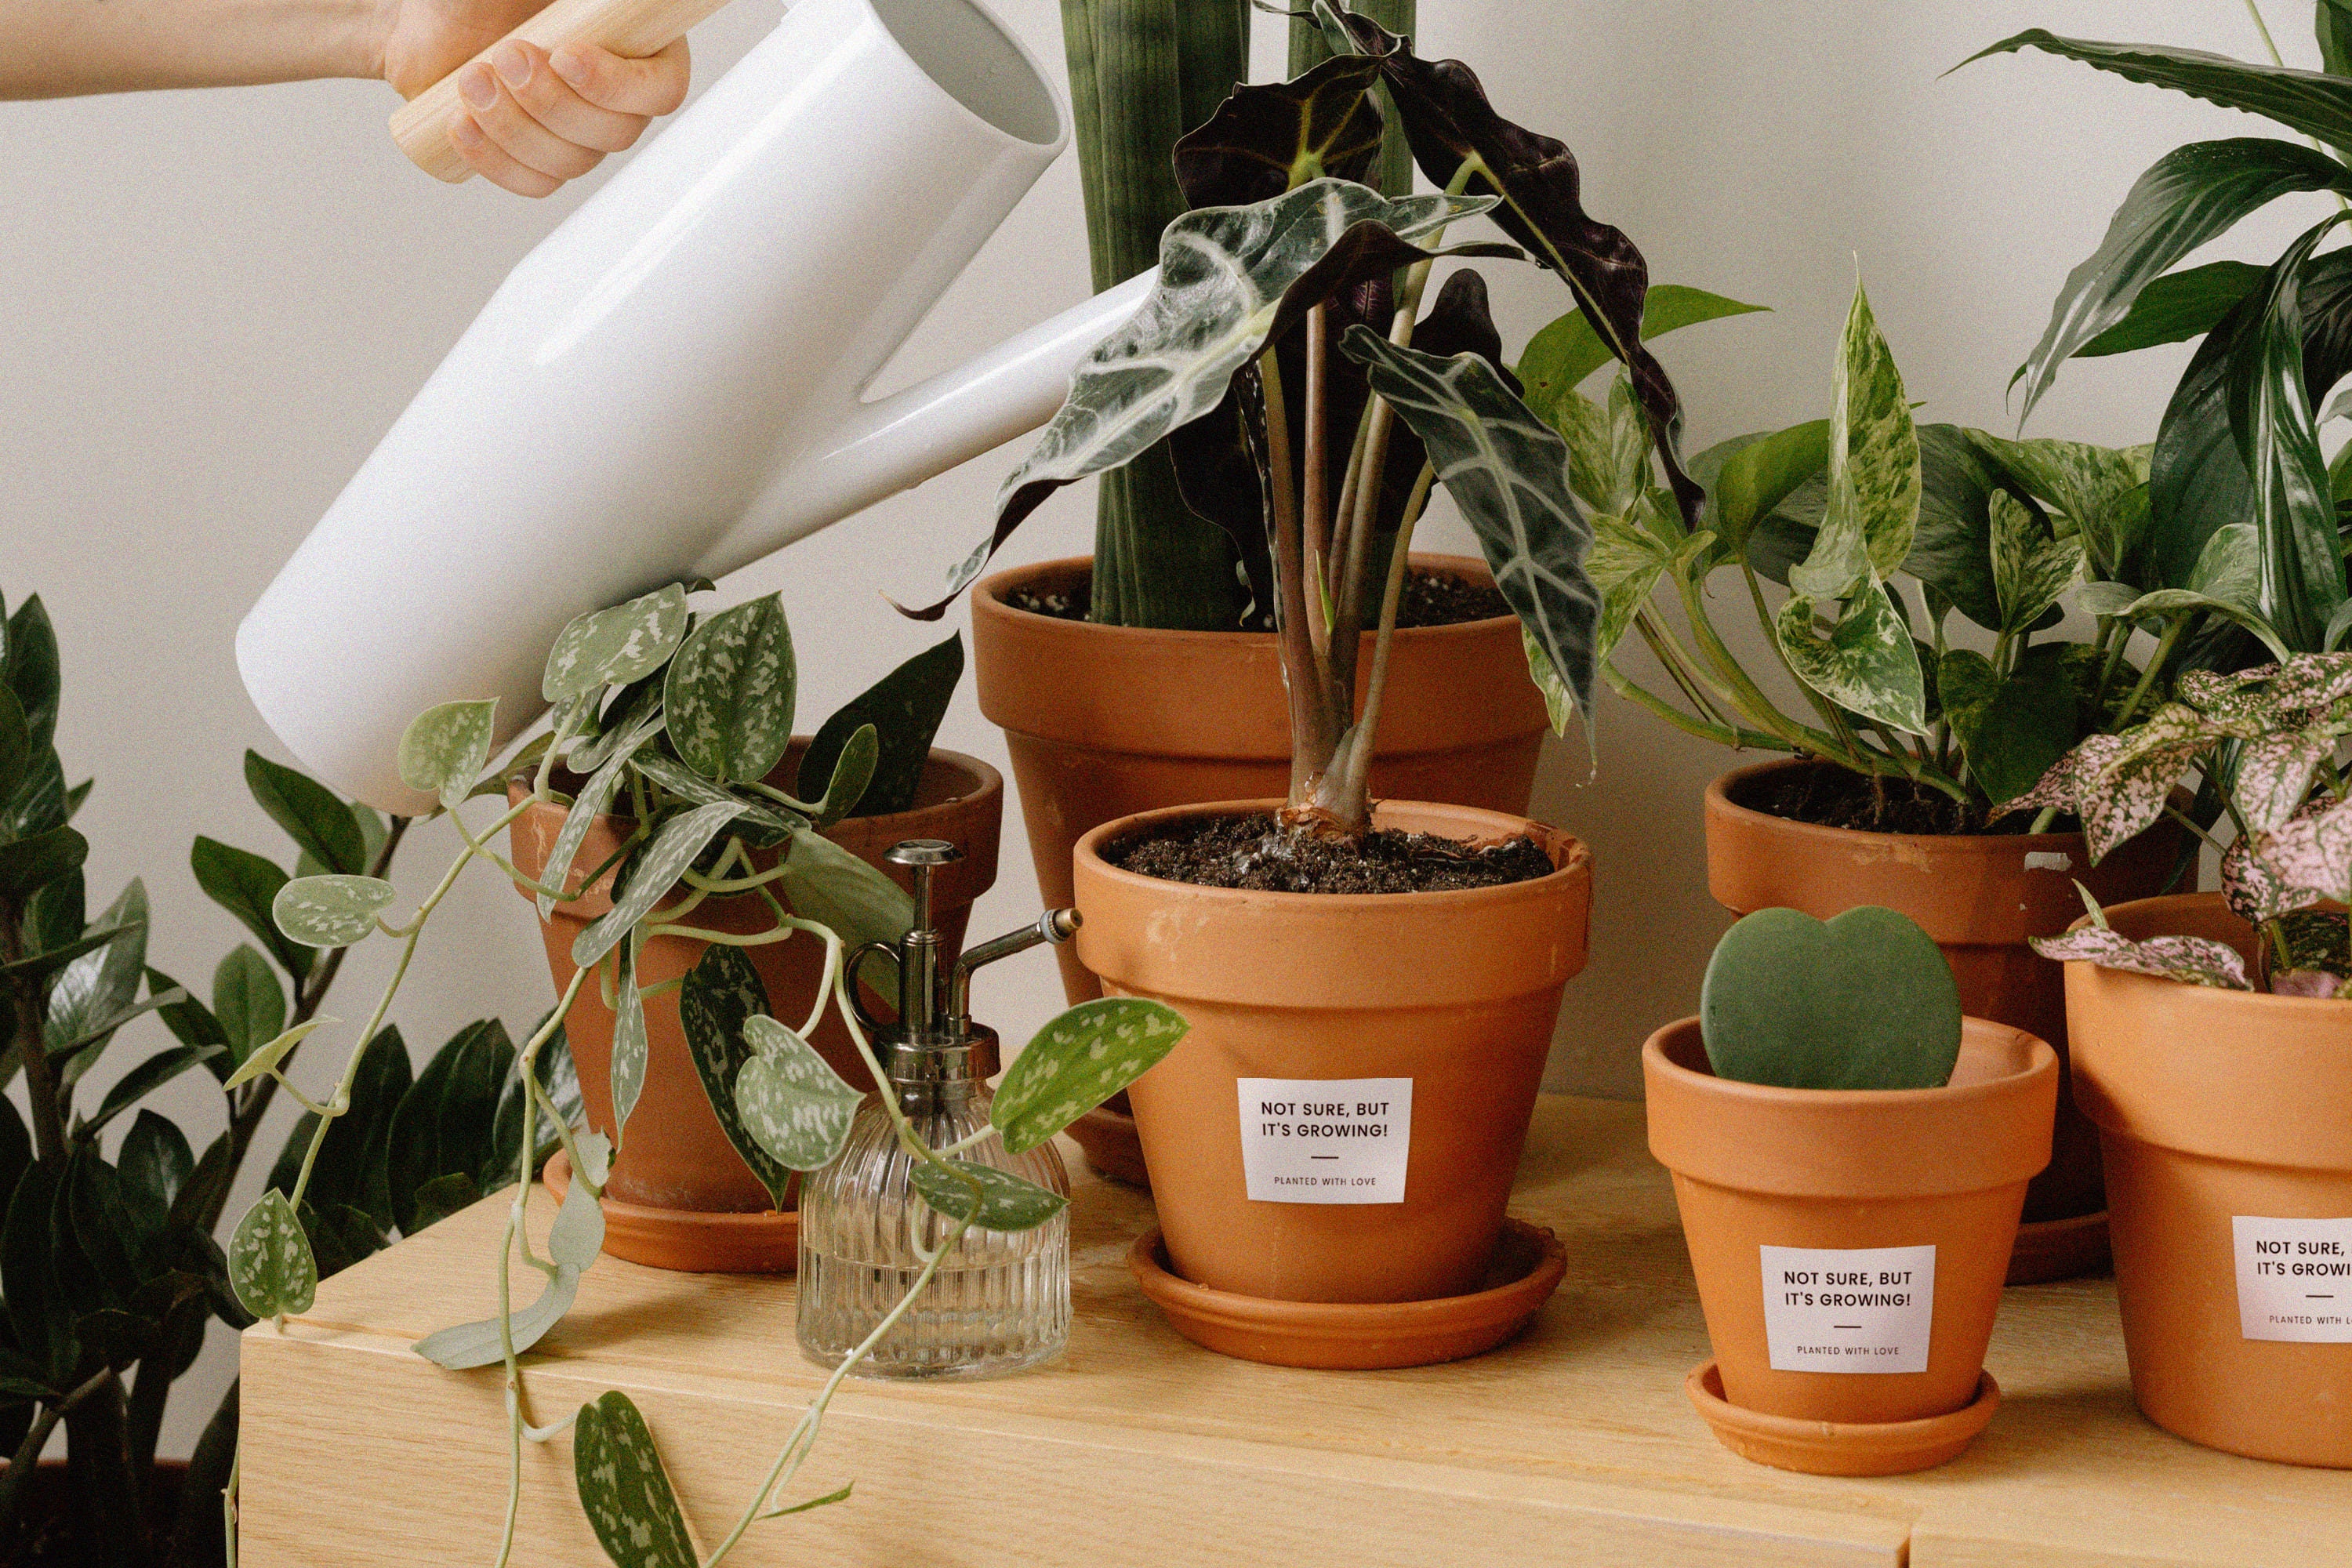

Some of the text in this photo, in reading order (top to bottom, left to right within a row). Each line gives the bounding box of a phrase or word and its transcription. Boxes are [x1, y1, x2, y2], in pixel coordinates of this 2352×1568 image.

[1261, 1102, 1389, 1119] NOT SURE, BUT
[1261, 1122, 1388, 1138] IT'S GROWING!
[1273, 1176, 1377, 1186] PLANTED WITH LOVE
[2256, 1240, 2345, 1257] NOT SURE,
[2257, 1261, 2285, 1275] IT'S
[1784, 1271, 1912, 1287] NOT SURE, BUT
[1785, 1292, 1911, 1307] IT'S GROWING!
[2269, 1315, 2312, 1325] PLANTED
[2317, 1316, 2342, 1325] WITH
[1797, 1345, 1900, 1356] PLANTED WITH LOVE
